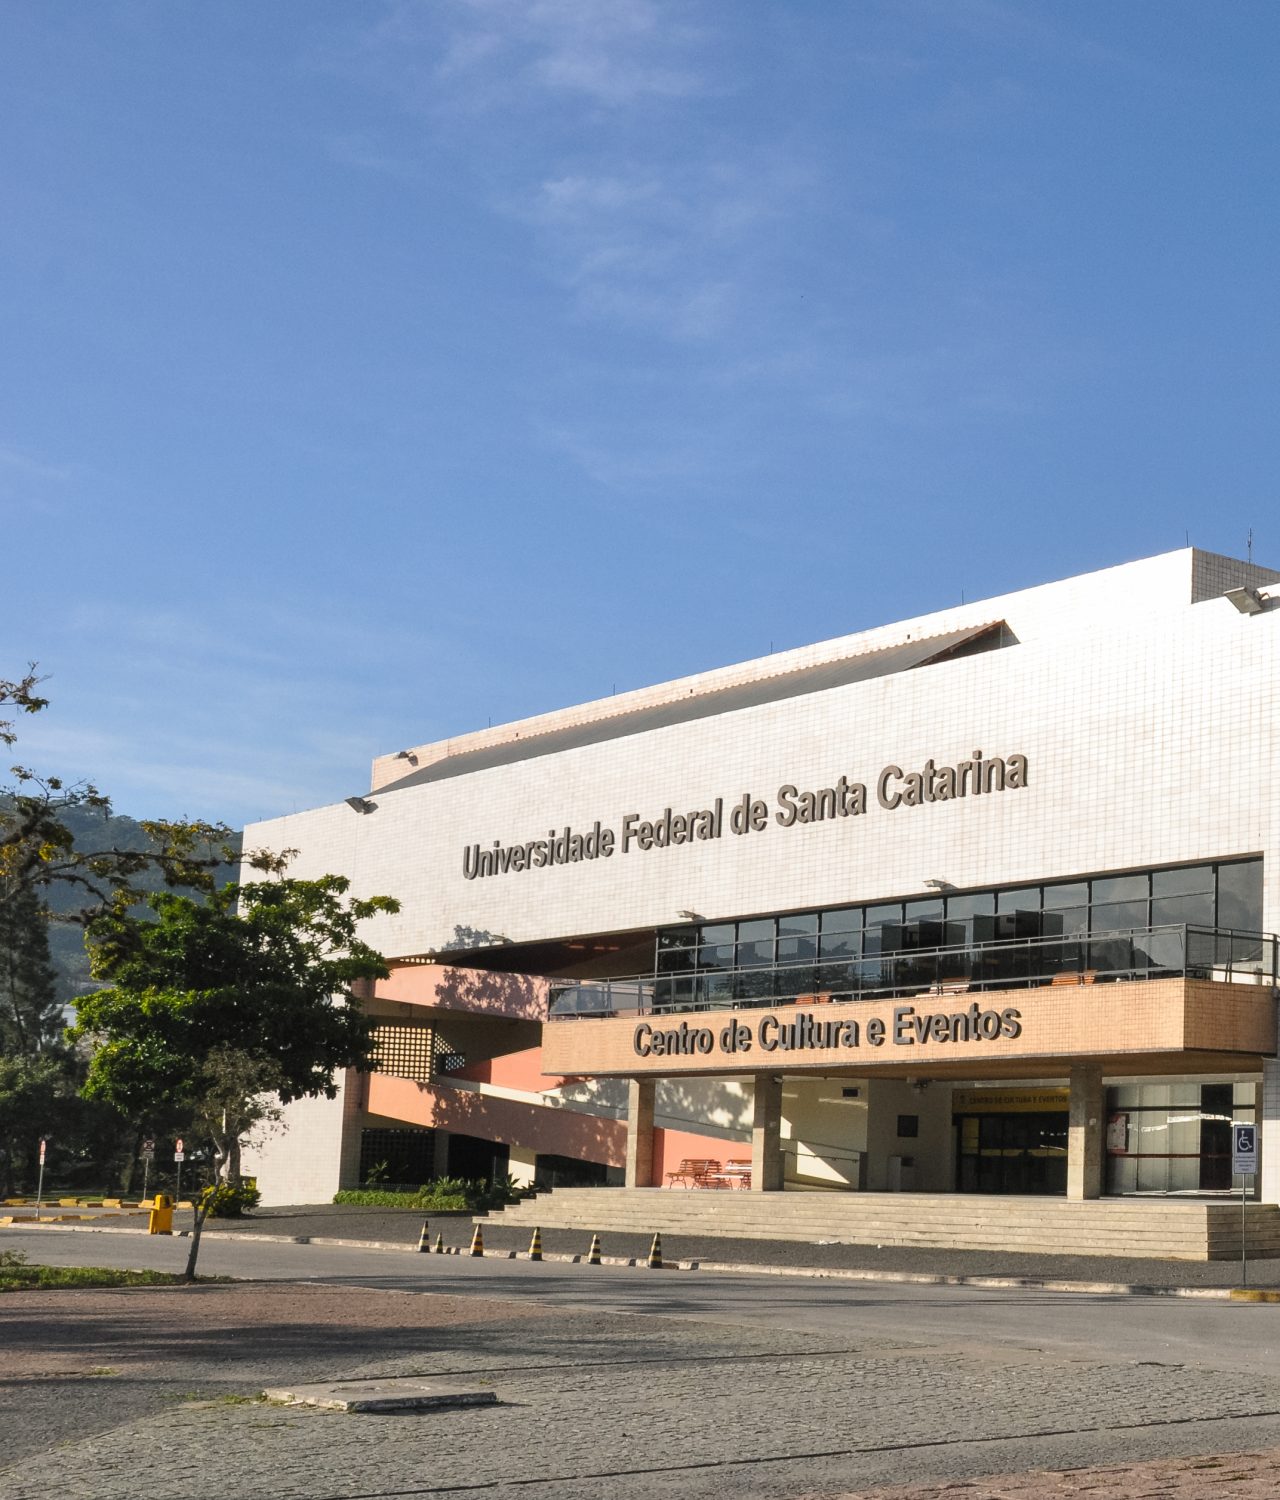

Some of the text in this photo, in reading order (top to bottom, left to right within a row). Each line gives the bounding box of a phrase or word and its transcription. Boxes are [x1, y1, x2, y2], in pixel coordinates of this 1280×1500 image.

[463, 750, 1028, 880] Universidade Federal de Santa Catarina
[633, 1002, 1022, 1057] Centro de Cultura e Eventos
